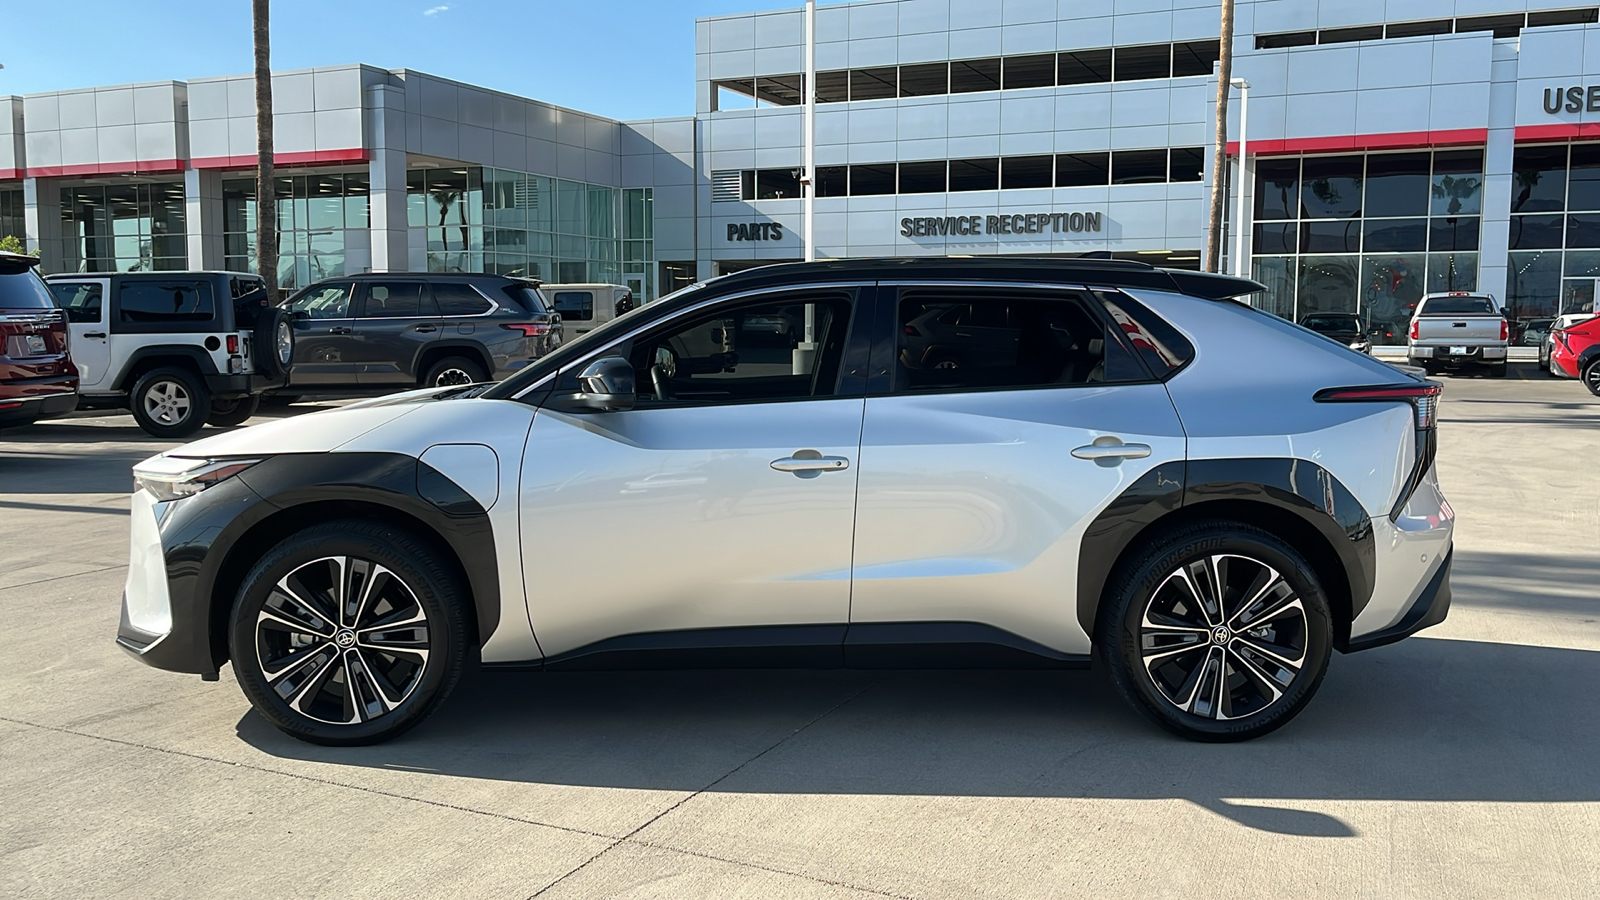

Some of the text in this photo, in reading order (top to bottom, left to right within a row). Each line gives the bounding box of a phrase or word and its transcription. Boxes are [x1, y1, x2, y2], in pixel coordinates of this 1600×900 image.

[1543, 86, 1600, 115] USE
[726, 222, 783, 241] PARTS
[901, 212, 1101, 238] SERVICE RECEPTION
[1142, 537, 1228, 591] BRIDGESTONE
